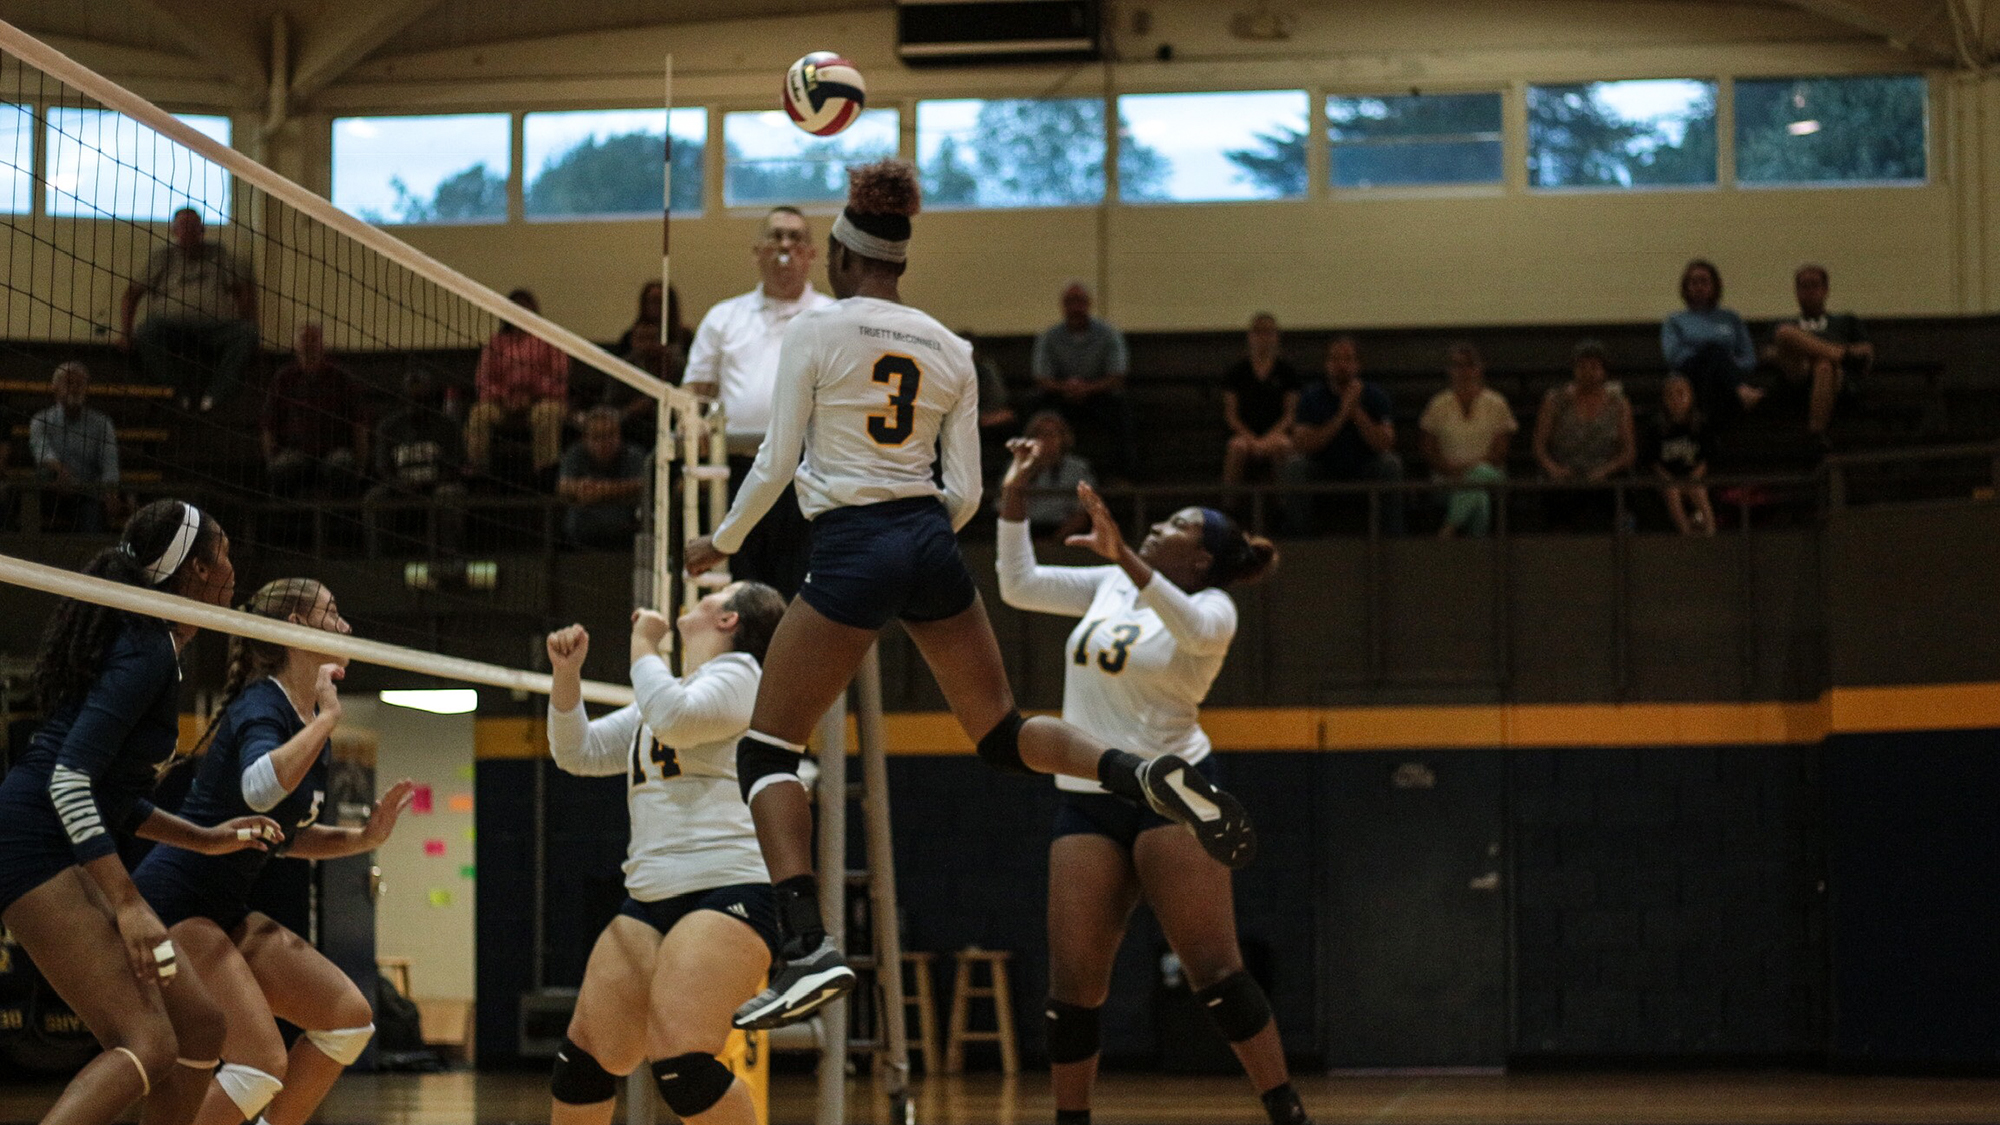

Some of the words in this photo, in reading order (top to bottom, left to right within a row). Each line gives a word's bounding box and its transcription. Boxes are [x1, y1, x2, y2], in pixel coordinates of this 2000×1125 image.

[859, 325, 891, 340] TRUETT
[866, 352, 922, 449] 3
[1074, 617, 1142, 676] 13
[632, 722, 683, 788] 14
